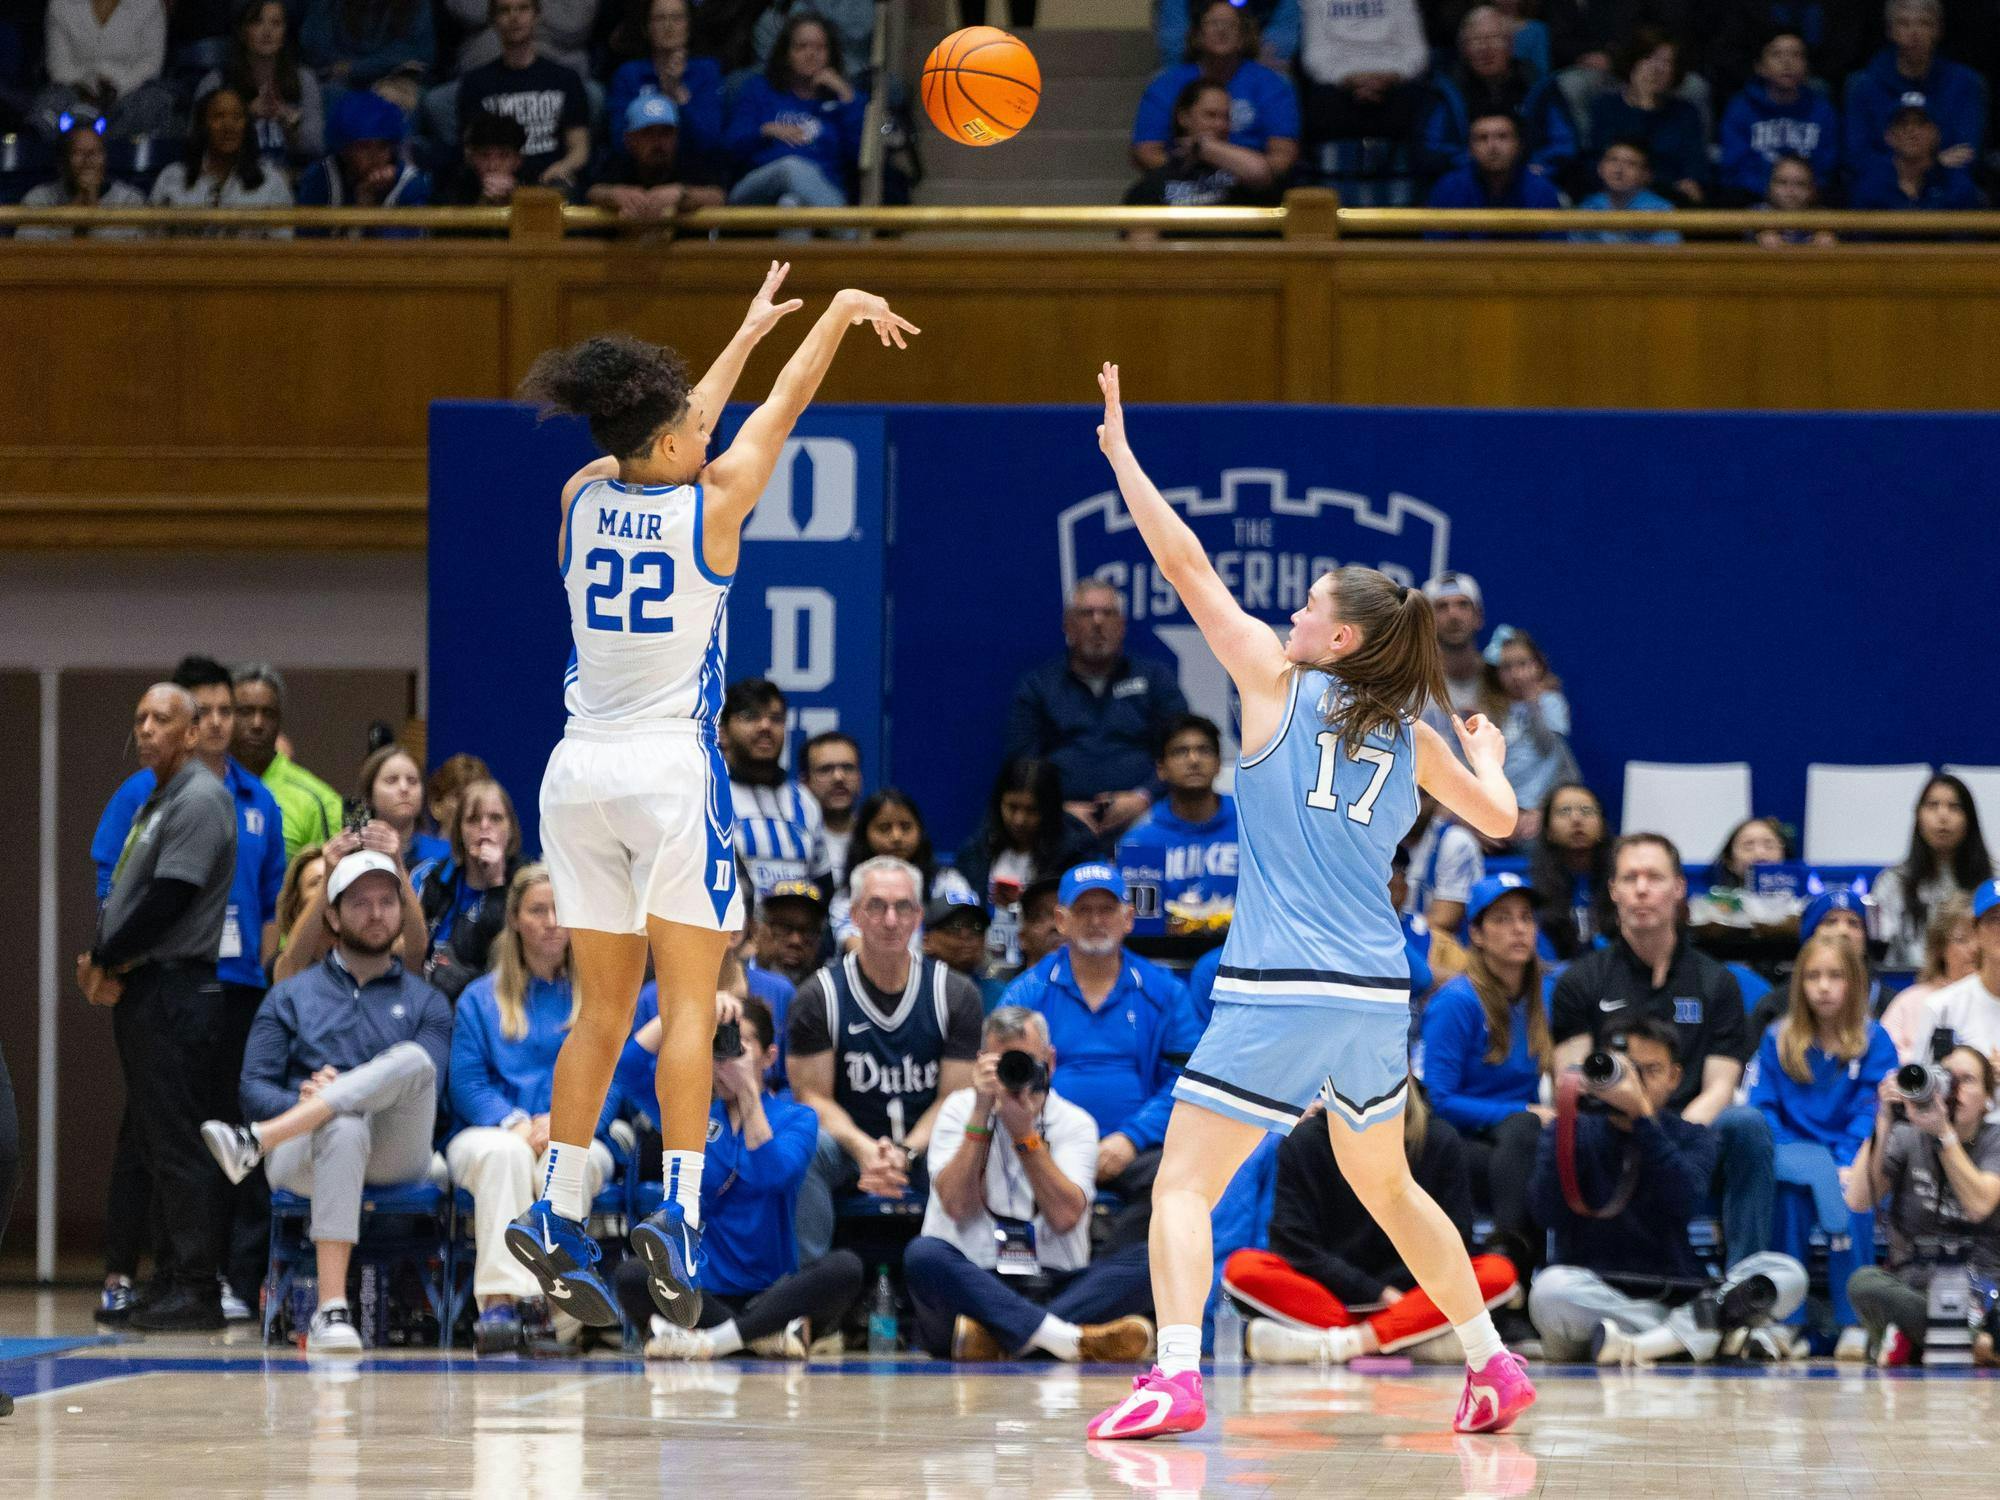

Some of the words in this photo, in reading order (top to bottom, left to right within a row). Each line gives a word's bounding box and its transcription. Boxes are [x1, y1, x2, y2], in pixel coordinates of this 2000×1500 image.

[597, 507, 662, 541] MAIR
[1232, 518, 1273, 546] THE
[585, 547, 675, 634] 22
[1306, 731, 1396, 827] 17
[712, 859, 732, 892] D
[843, 1051, 939, 1095] Duke
[886, 1096, 906, 1144] 1
